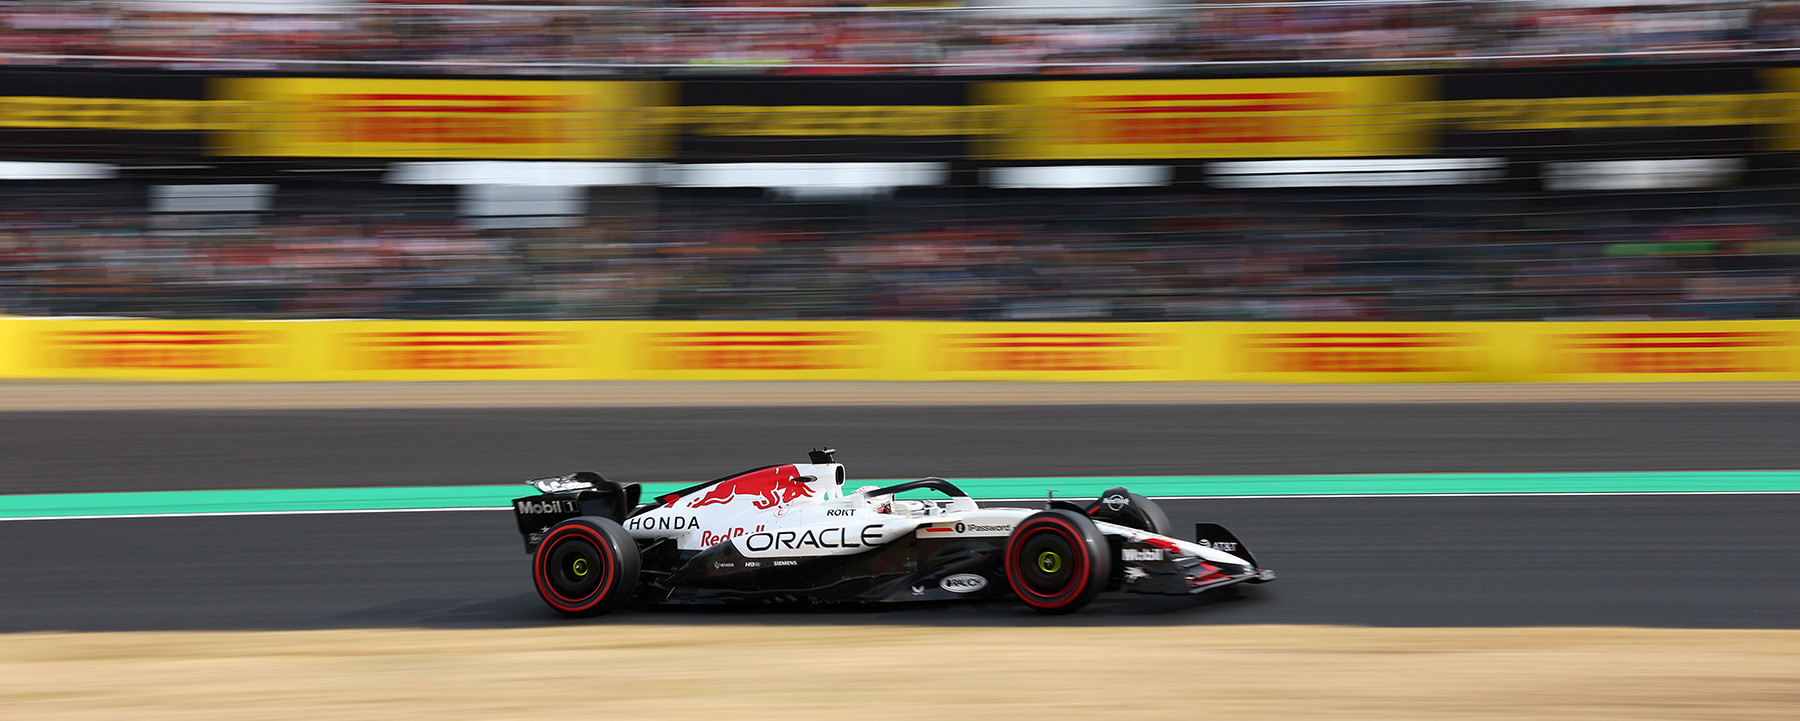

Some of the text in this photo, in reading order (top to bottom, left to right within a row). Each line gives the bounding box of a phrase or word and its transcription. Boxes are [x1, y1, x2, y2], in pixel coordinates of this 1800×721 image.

[517, 500, 562, 515] Mobil
[826, 508, 857, 517] ROKT
[629, 516, 700, 530] HONDA
[967, 524, 1011, 532] 1Password
[745, 523, 884, 552] ORACLE
